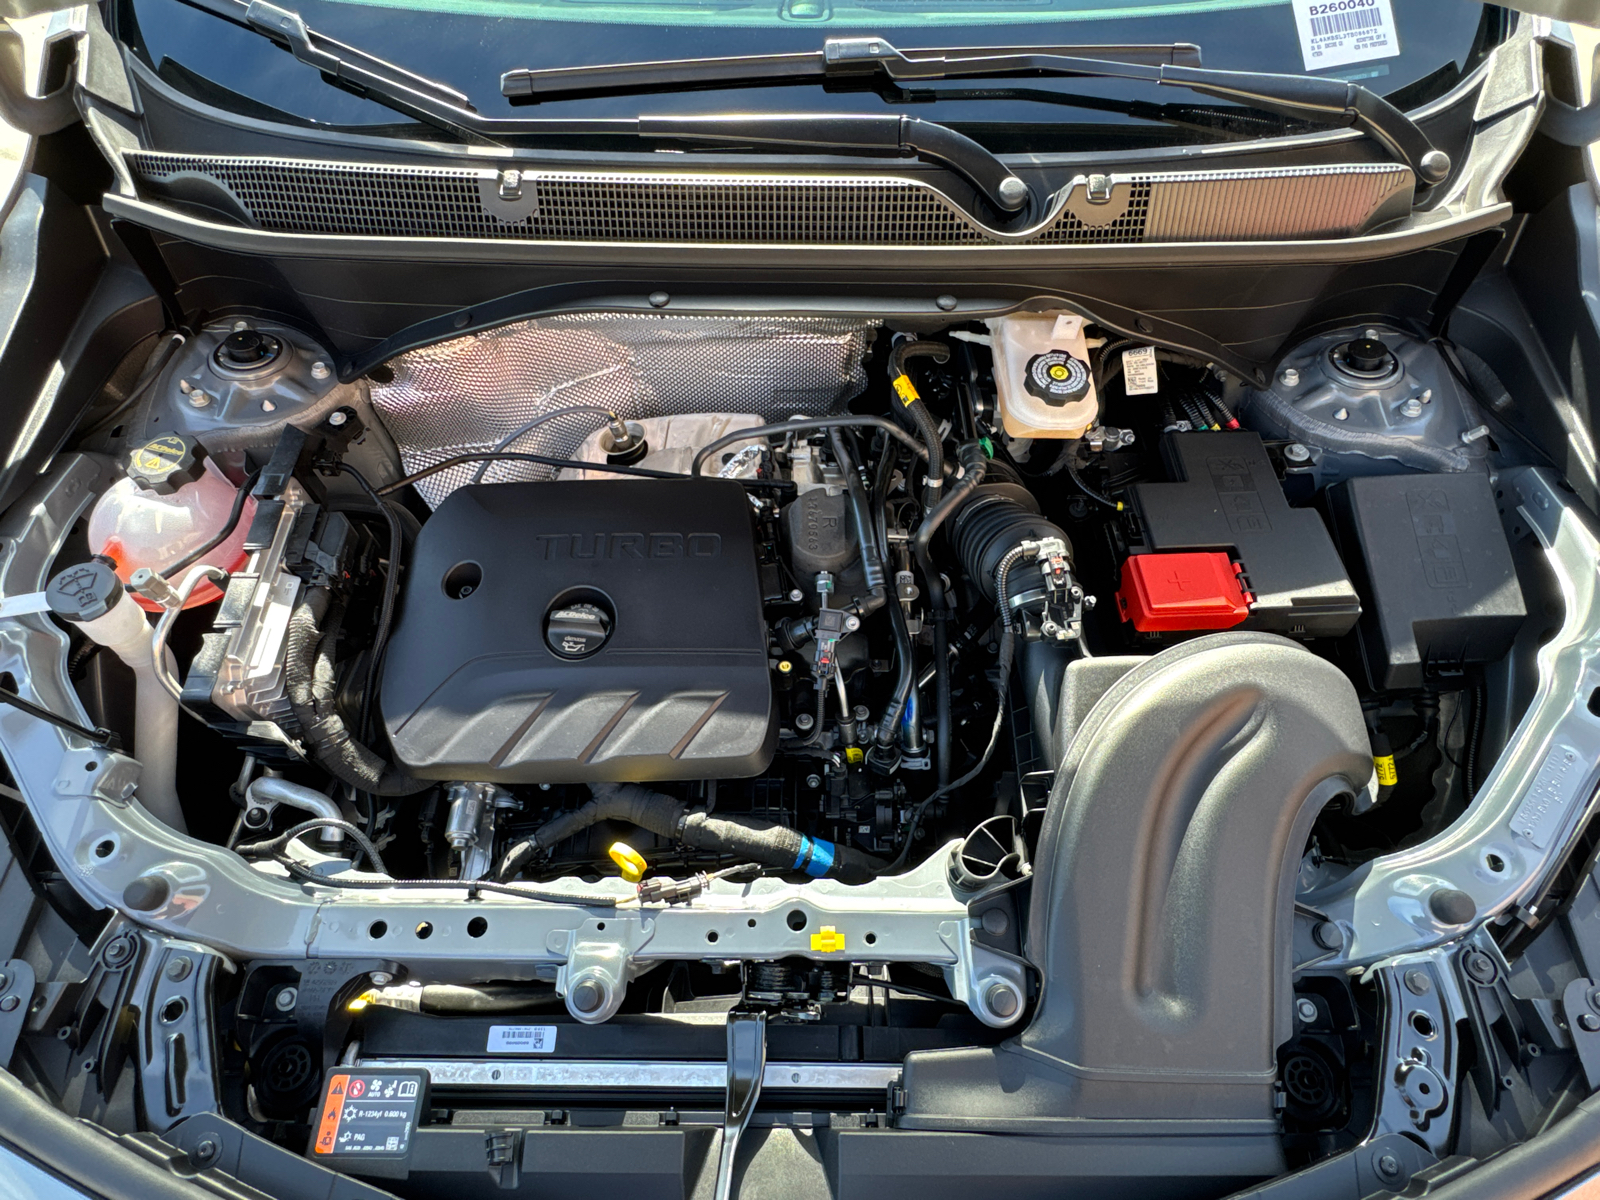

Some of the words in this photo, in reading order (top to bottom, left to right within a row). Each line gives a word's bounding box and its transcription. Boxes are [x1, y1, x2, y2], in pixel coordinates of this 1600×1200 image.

[1309, 0, 1375, 16] B260040
[148, 444, 183, 455] ACDelco
[822, 516, 837, 528] R
[536, 532, 722, 560] TURBO
[554, 610, 596, 619] ACDelco
[400, 1110, 408, 1119] kg
[353, 1133, 366, 1141] PAG
